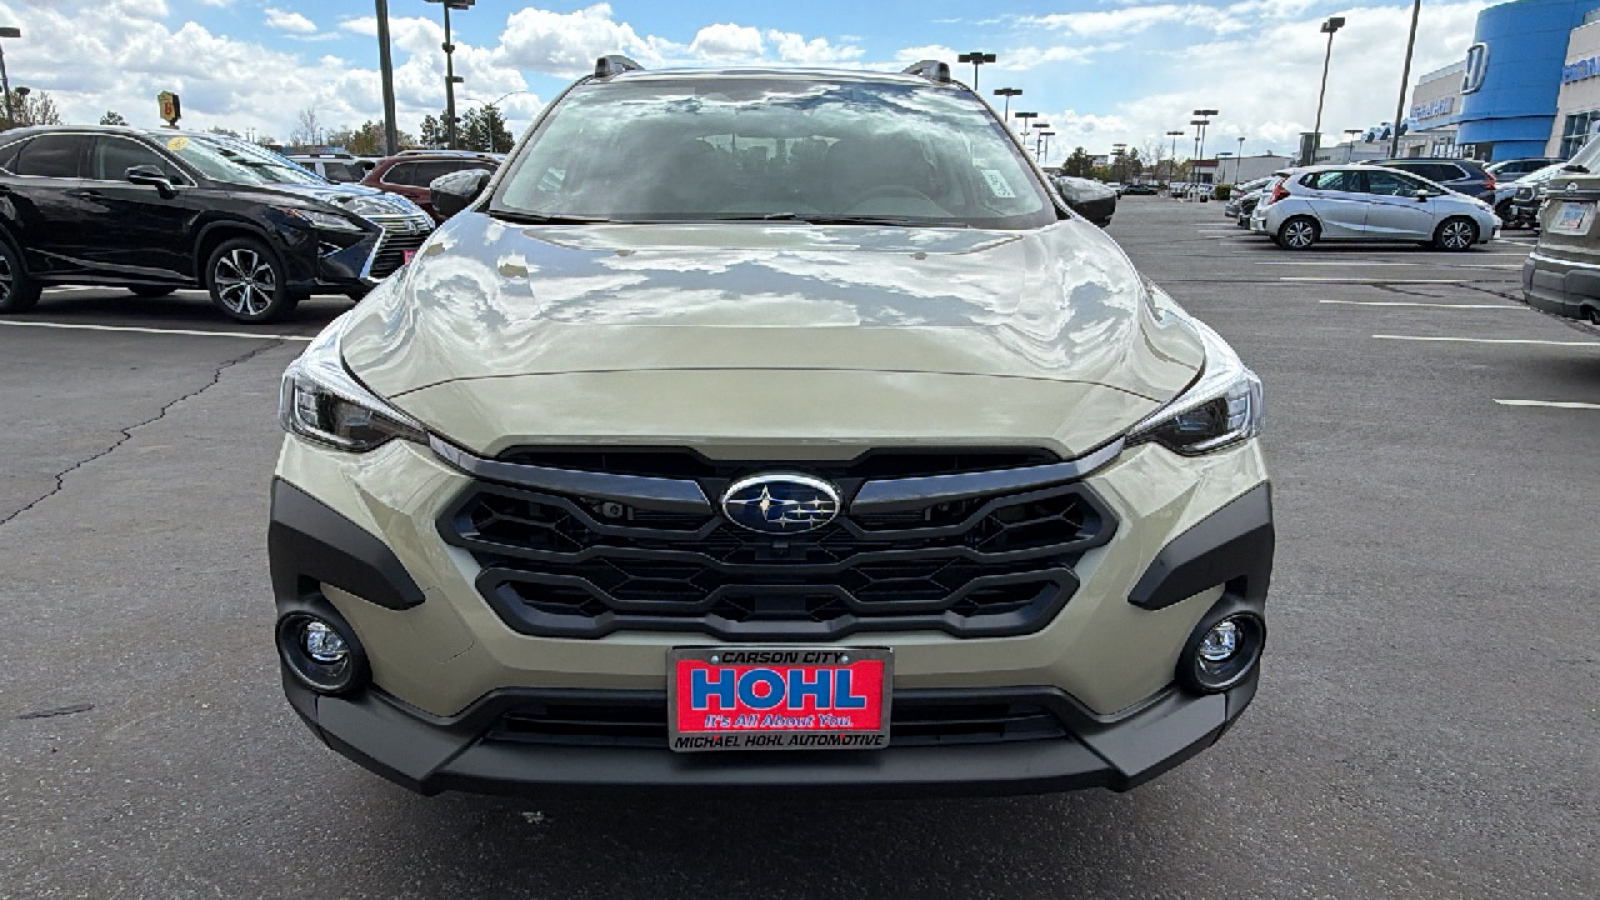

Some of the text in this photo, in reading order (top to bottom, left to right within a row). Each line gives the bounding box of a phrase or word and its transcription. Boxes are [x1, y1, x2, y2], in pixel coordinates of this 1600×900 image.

[722, 652, 844, 664] CARSON CITY
[691, 668, 866, 710] HOHL
[705, 714, 853, 727] It's All About You.
[675, 734, 885, 748] MICHAEL HOHL AUTOMOTIVE
